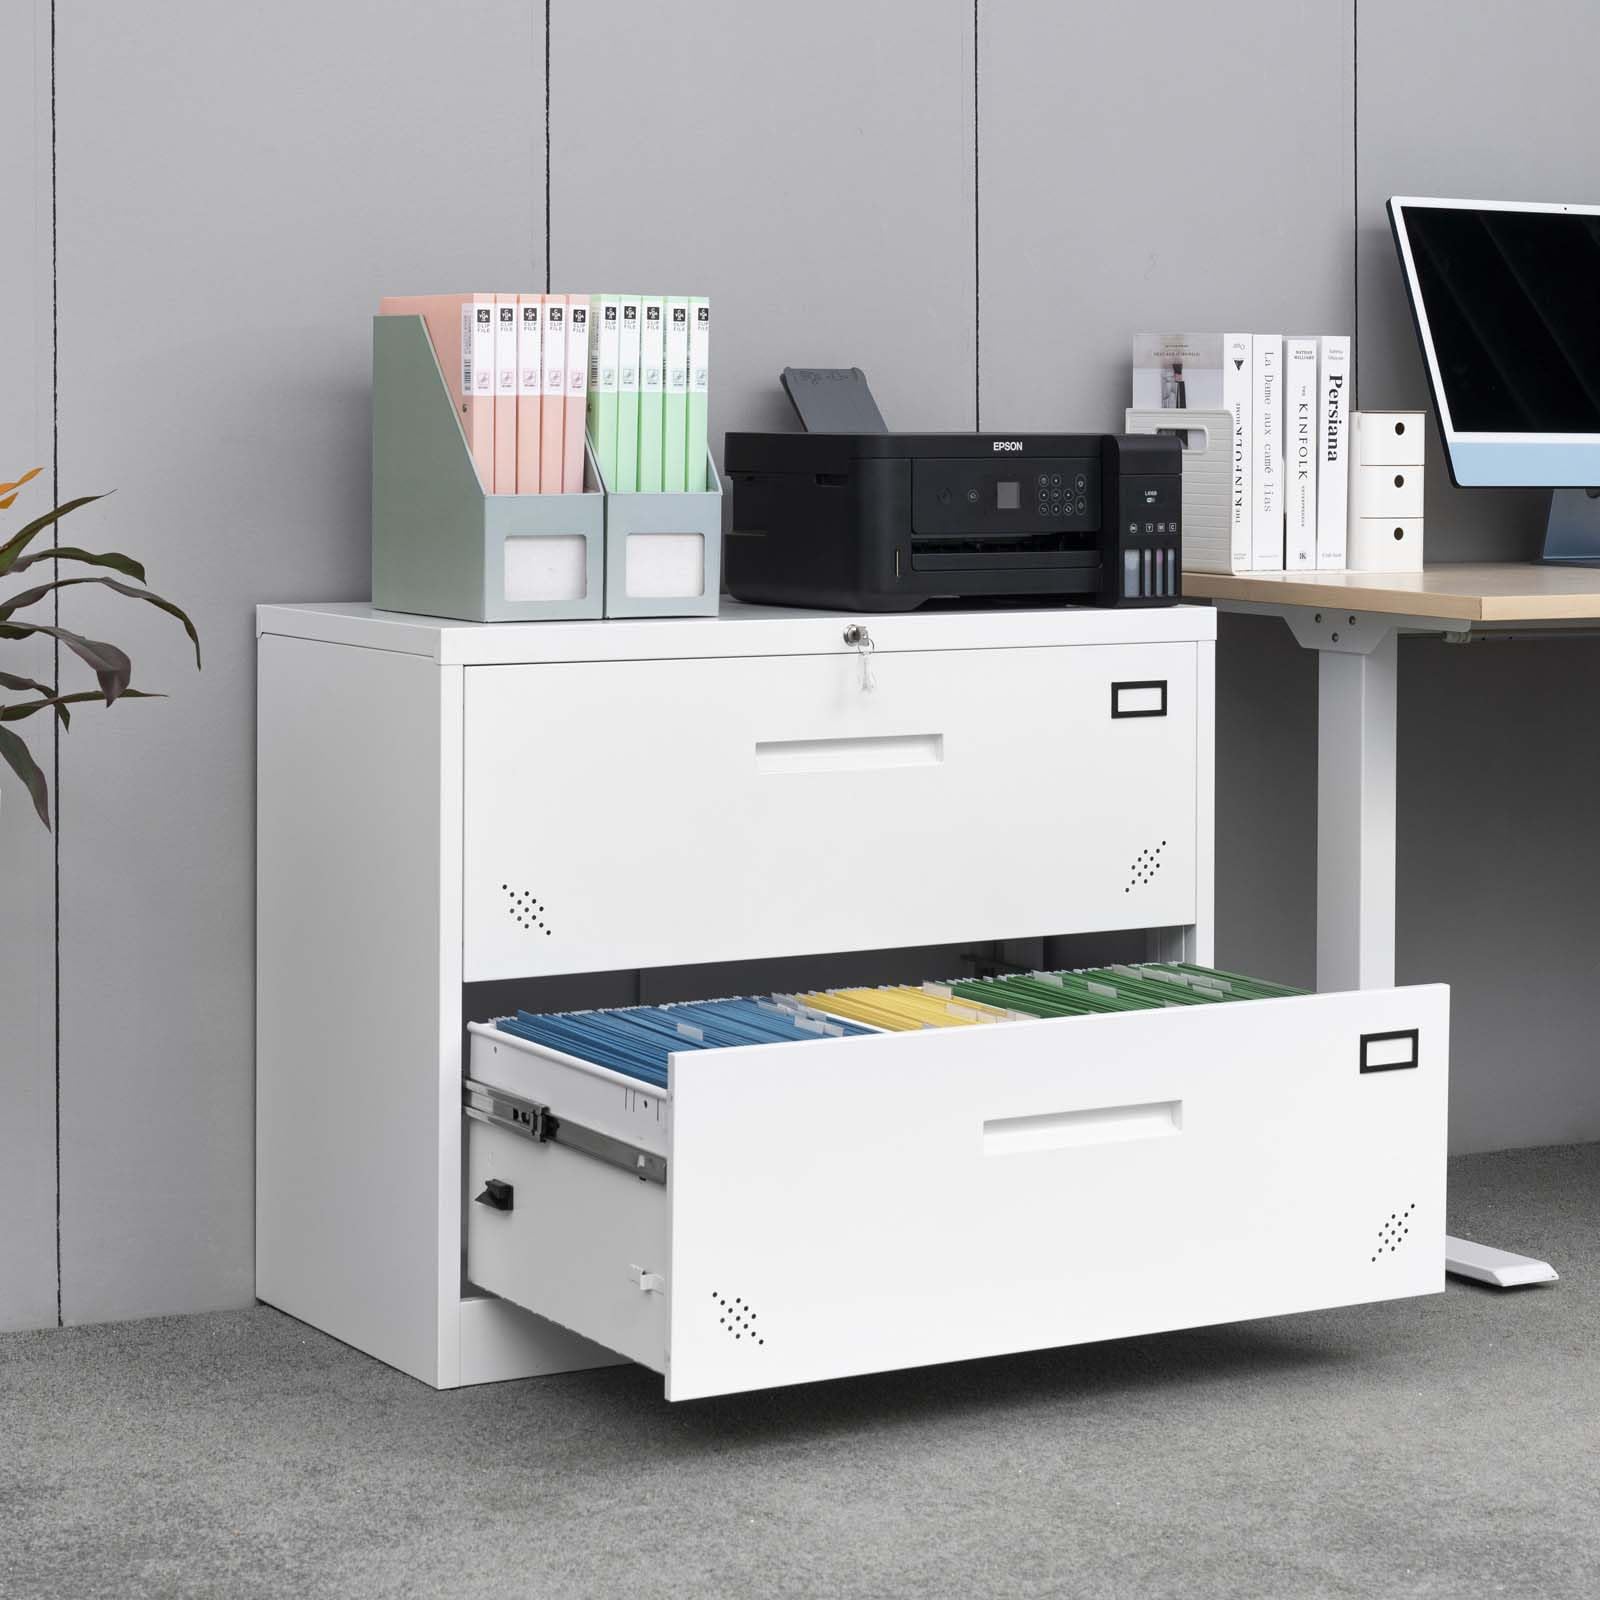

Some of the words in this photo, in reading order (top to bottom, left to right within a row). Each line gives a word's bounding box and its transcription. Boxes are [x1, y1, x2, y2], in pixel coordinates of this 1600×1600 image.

[1264, 352, 1274, 366] La
[1264, 375, 1274, 405] Dame
[1328, 375, 1343, 462] Persiana
[994, 442, 1022, 450] EPSON
[1299, 403, 1308, 480] KINFOLK
